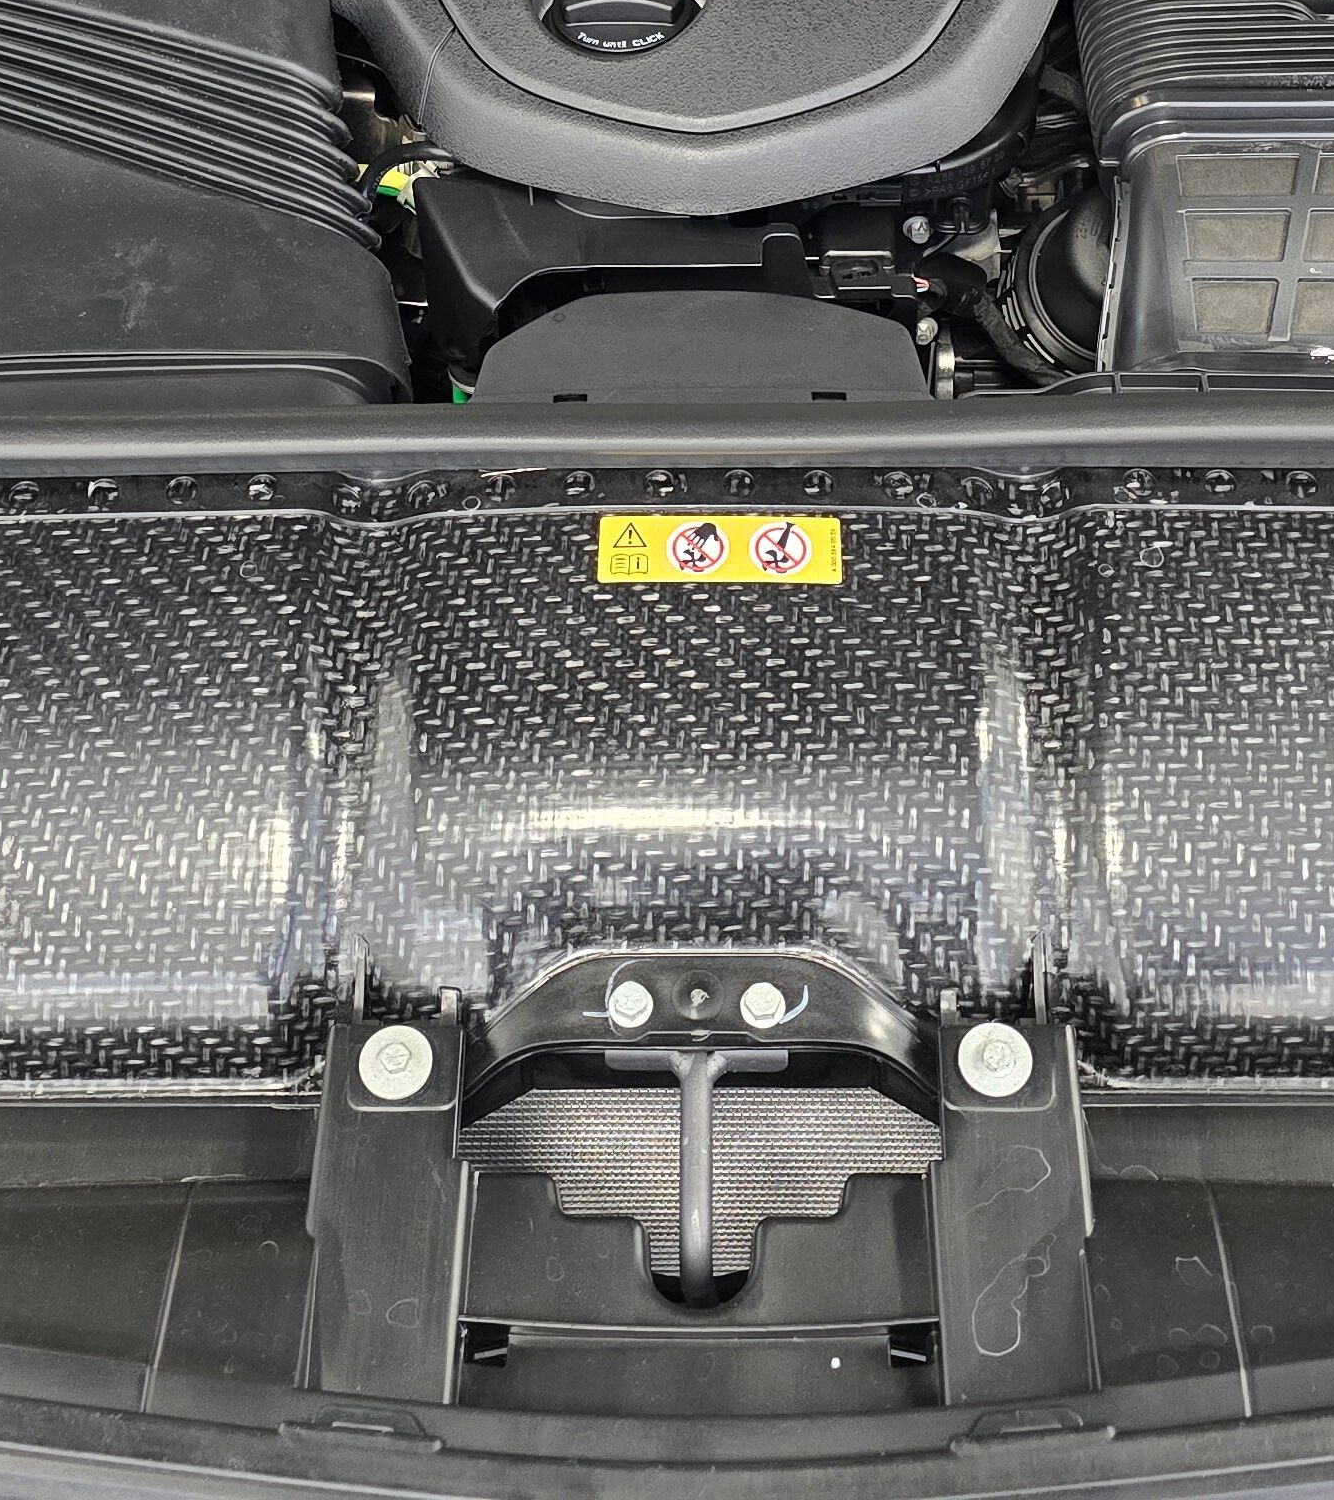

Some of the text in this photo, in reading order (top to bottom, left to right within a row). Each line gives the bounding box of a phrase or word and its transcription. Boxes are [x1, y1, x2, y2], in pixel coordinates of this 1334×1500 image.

[578, 31, 665, 48] Turn until CLICK
